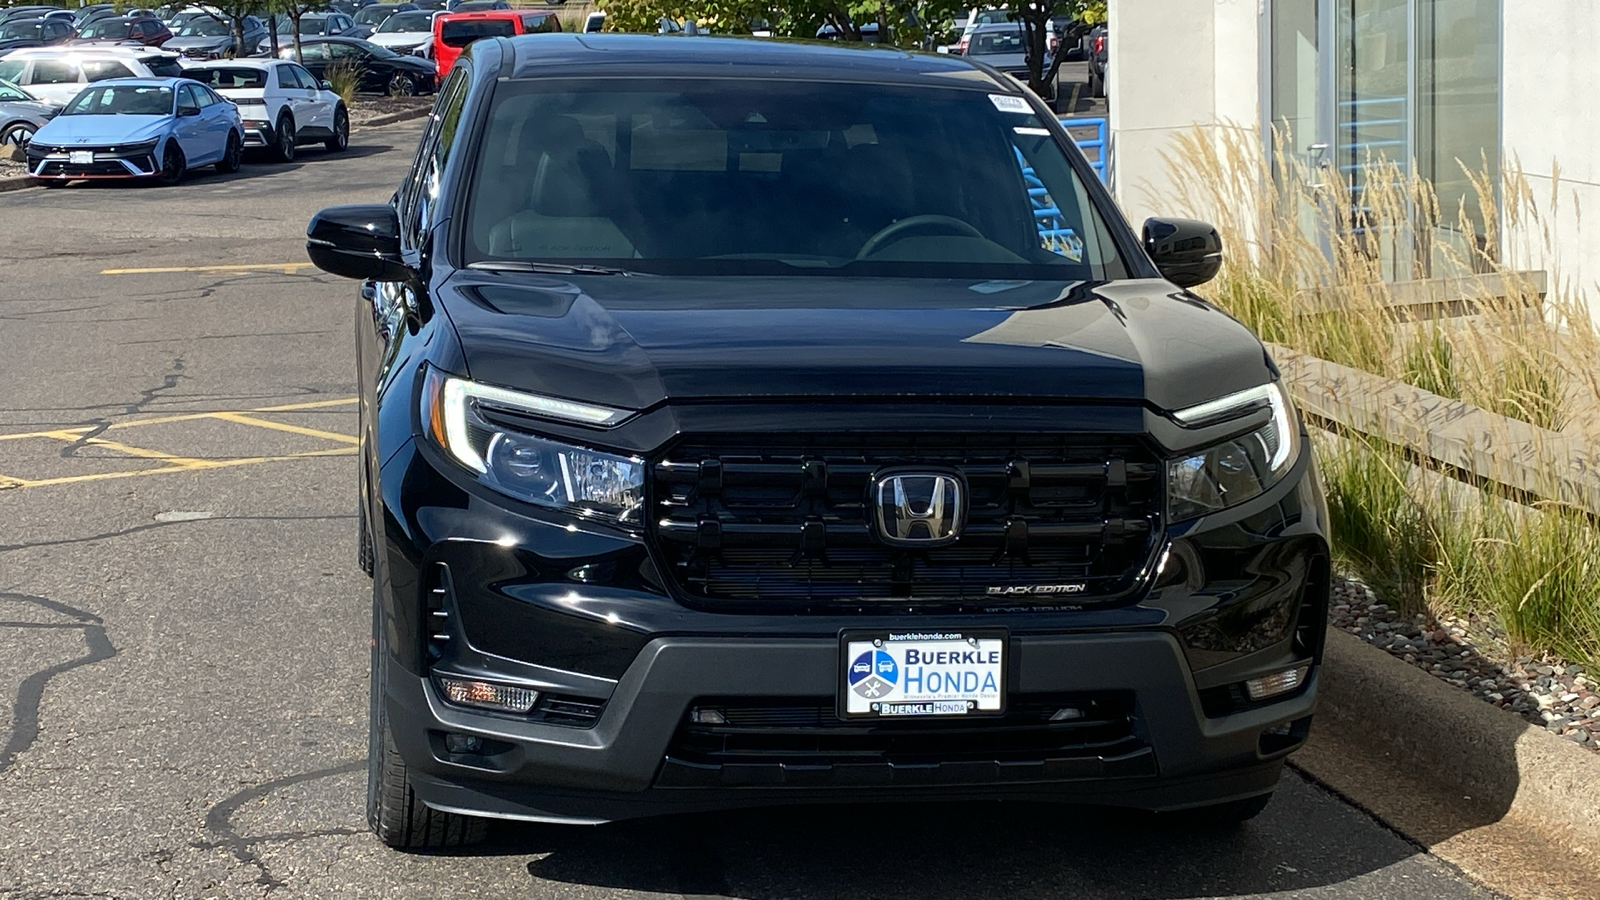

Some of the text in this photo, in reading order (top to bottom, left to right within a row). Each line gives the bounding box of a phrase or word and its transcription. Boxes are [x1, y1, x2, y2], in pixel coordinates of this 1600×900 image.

[986, 584, 1086, 595] BLACK EDITION
[889, 632, 962, 641] buerklehonda.com
[905, 649, 1000, 665] BUERKLE
[904, 666, 998, 693] HONDA
